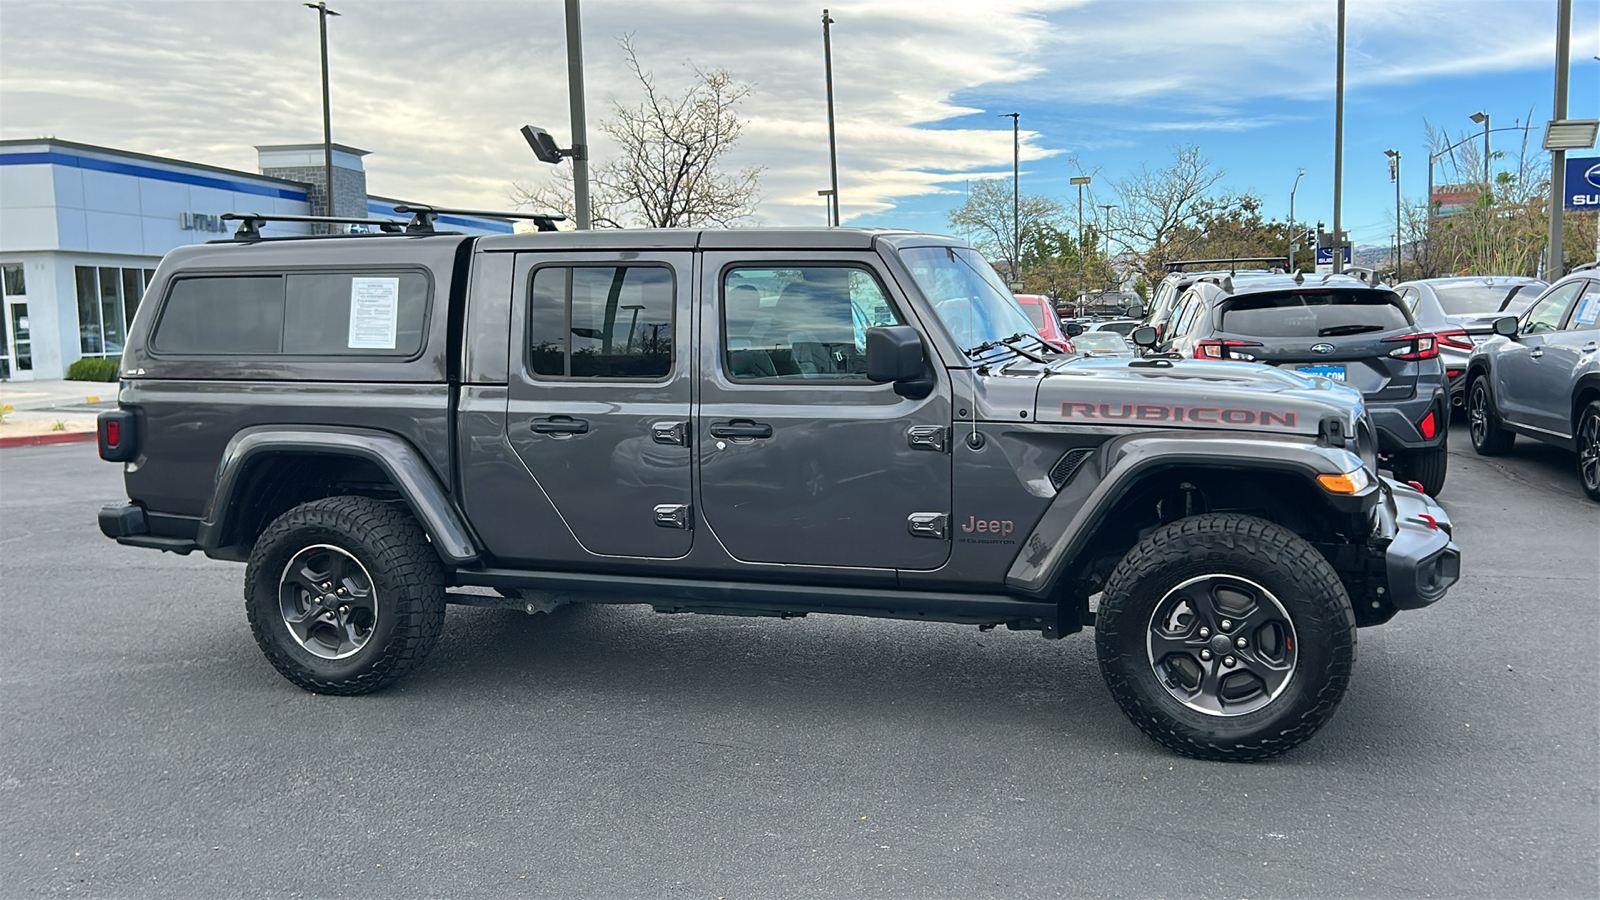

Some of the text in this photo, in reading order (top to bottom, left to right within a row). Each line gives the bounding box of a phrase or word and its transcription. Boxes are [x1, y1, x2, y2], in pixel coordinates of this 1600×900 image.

[1573, 194, 1600, 206] SU
[1060, 401, 1298, 428] RUBICON
[962, 515, 1014, 537] Jeep
